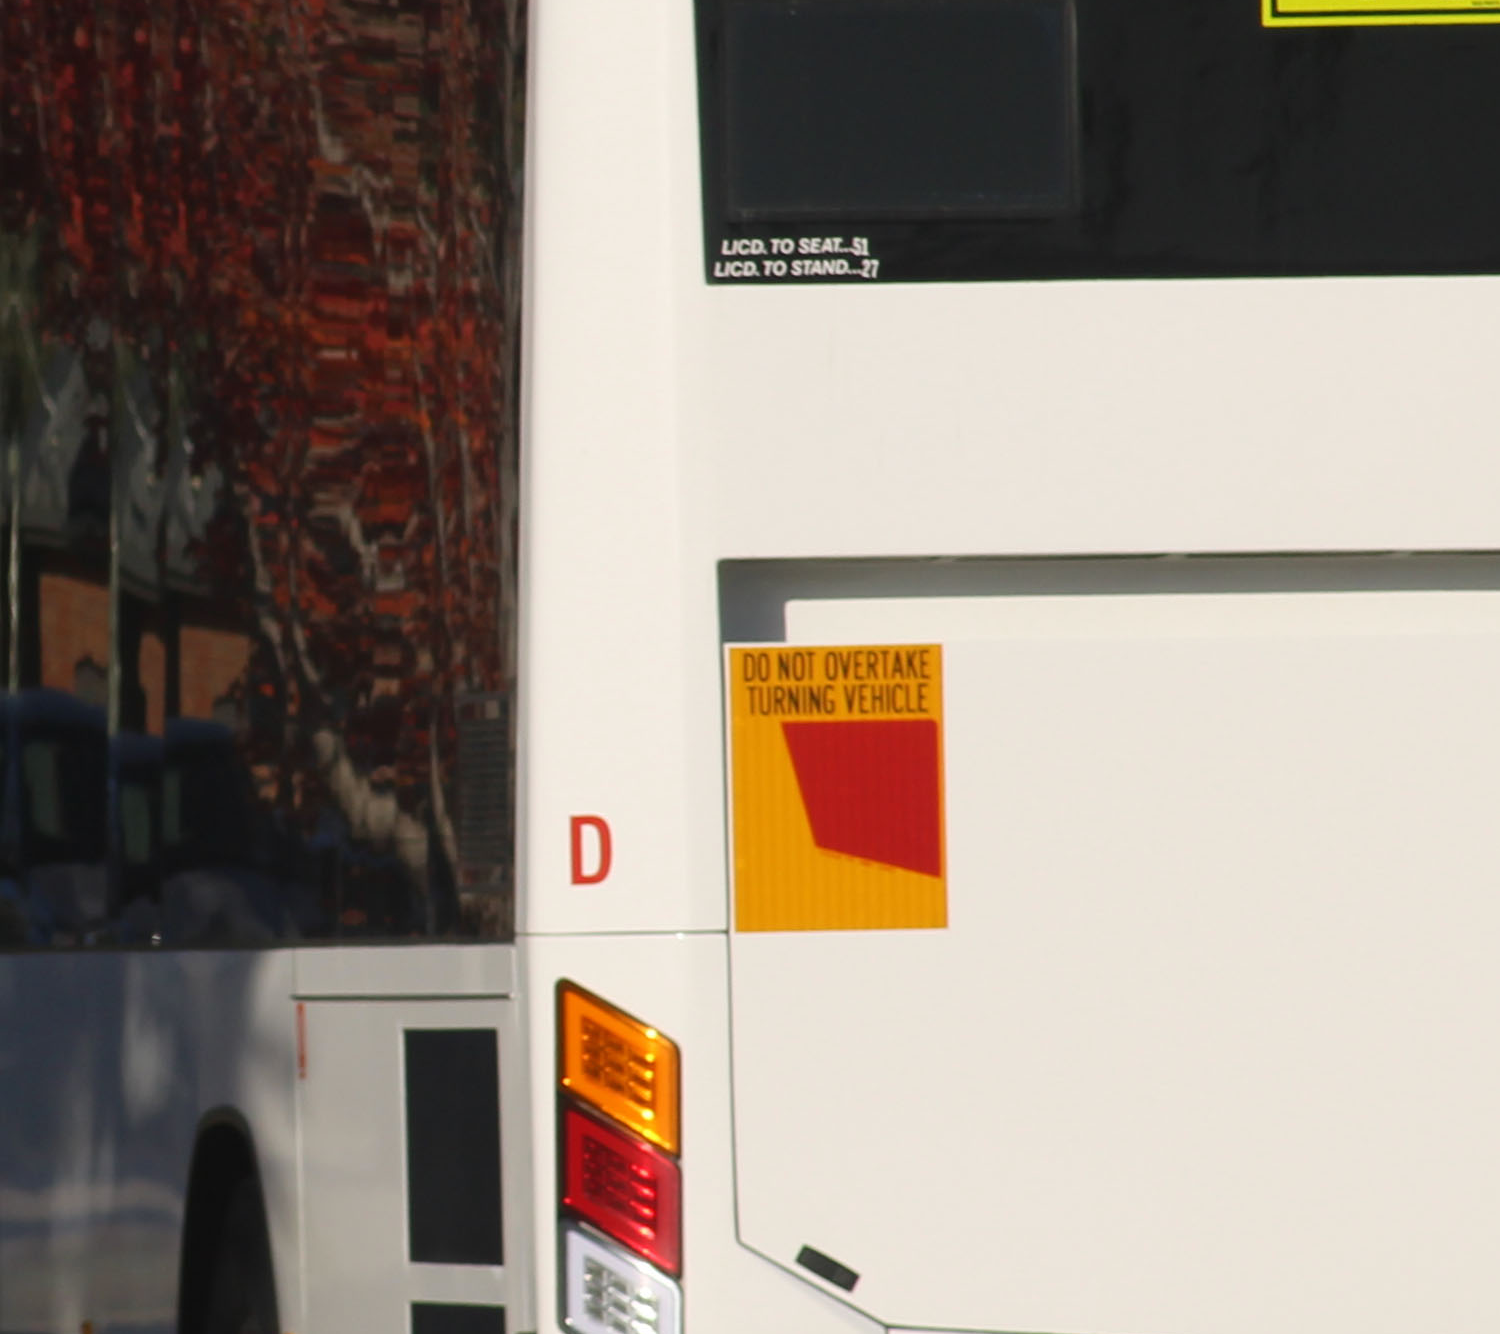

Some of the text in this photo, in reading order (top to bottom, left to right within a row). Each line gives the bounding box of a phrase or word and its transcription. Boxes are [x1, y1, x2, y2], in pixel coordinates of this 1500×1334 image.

[721, 238, 767, 255] LICD.
[770, 238, 795, 255] TO
[713, 261, 759, 278] LICD.
[763, 260, 788, 277] TO
[743, 649, 931, 682] DO NOT OVERTAKE
[746, 683, 929, 715] TURNING VEHICLE
[570, 814, 612, 885] D
